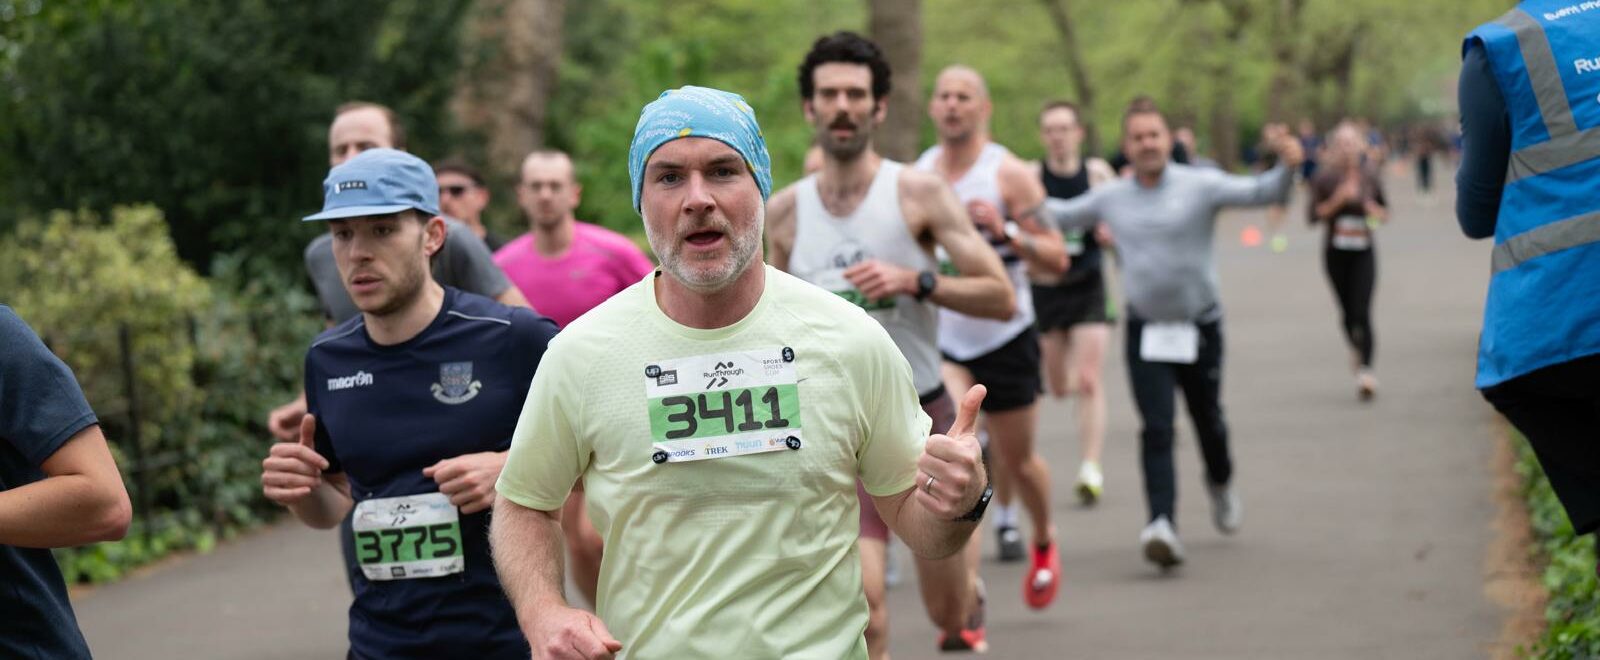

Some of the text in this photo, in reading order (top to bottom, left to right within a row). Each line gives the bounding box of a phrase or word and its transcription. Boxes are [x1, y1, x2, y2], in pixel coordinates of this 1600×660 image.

[327, 370, 373, 391] macron
[661, 386, 789, 439] 3411
[705, 446, 728, 455] TREK
[358, 523, 457, 564] 3775
